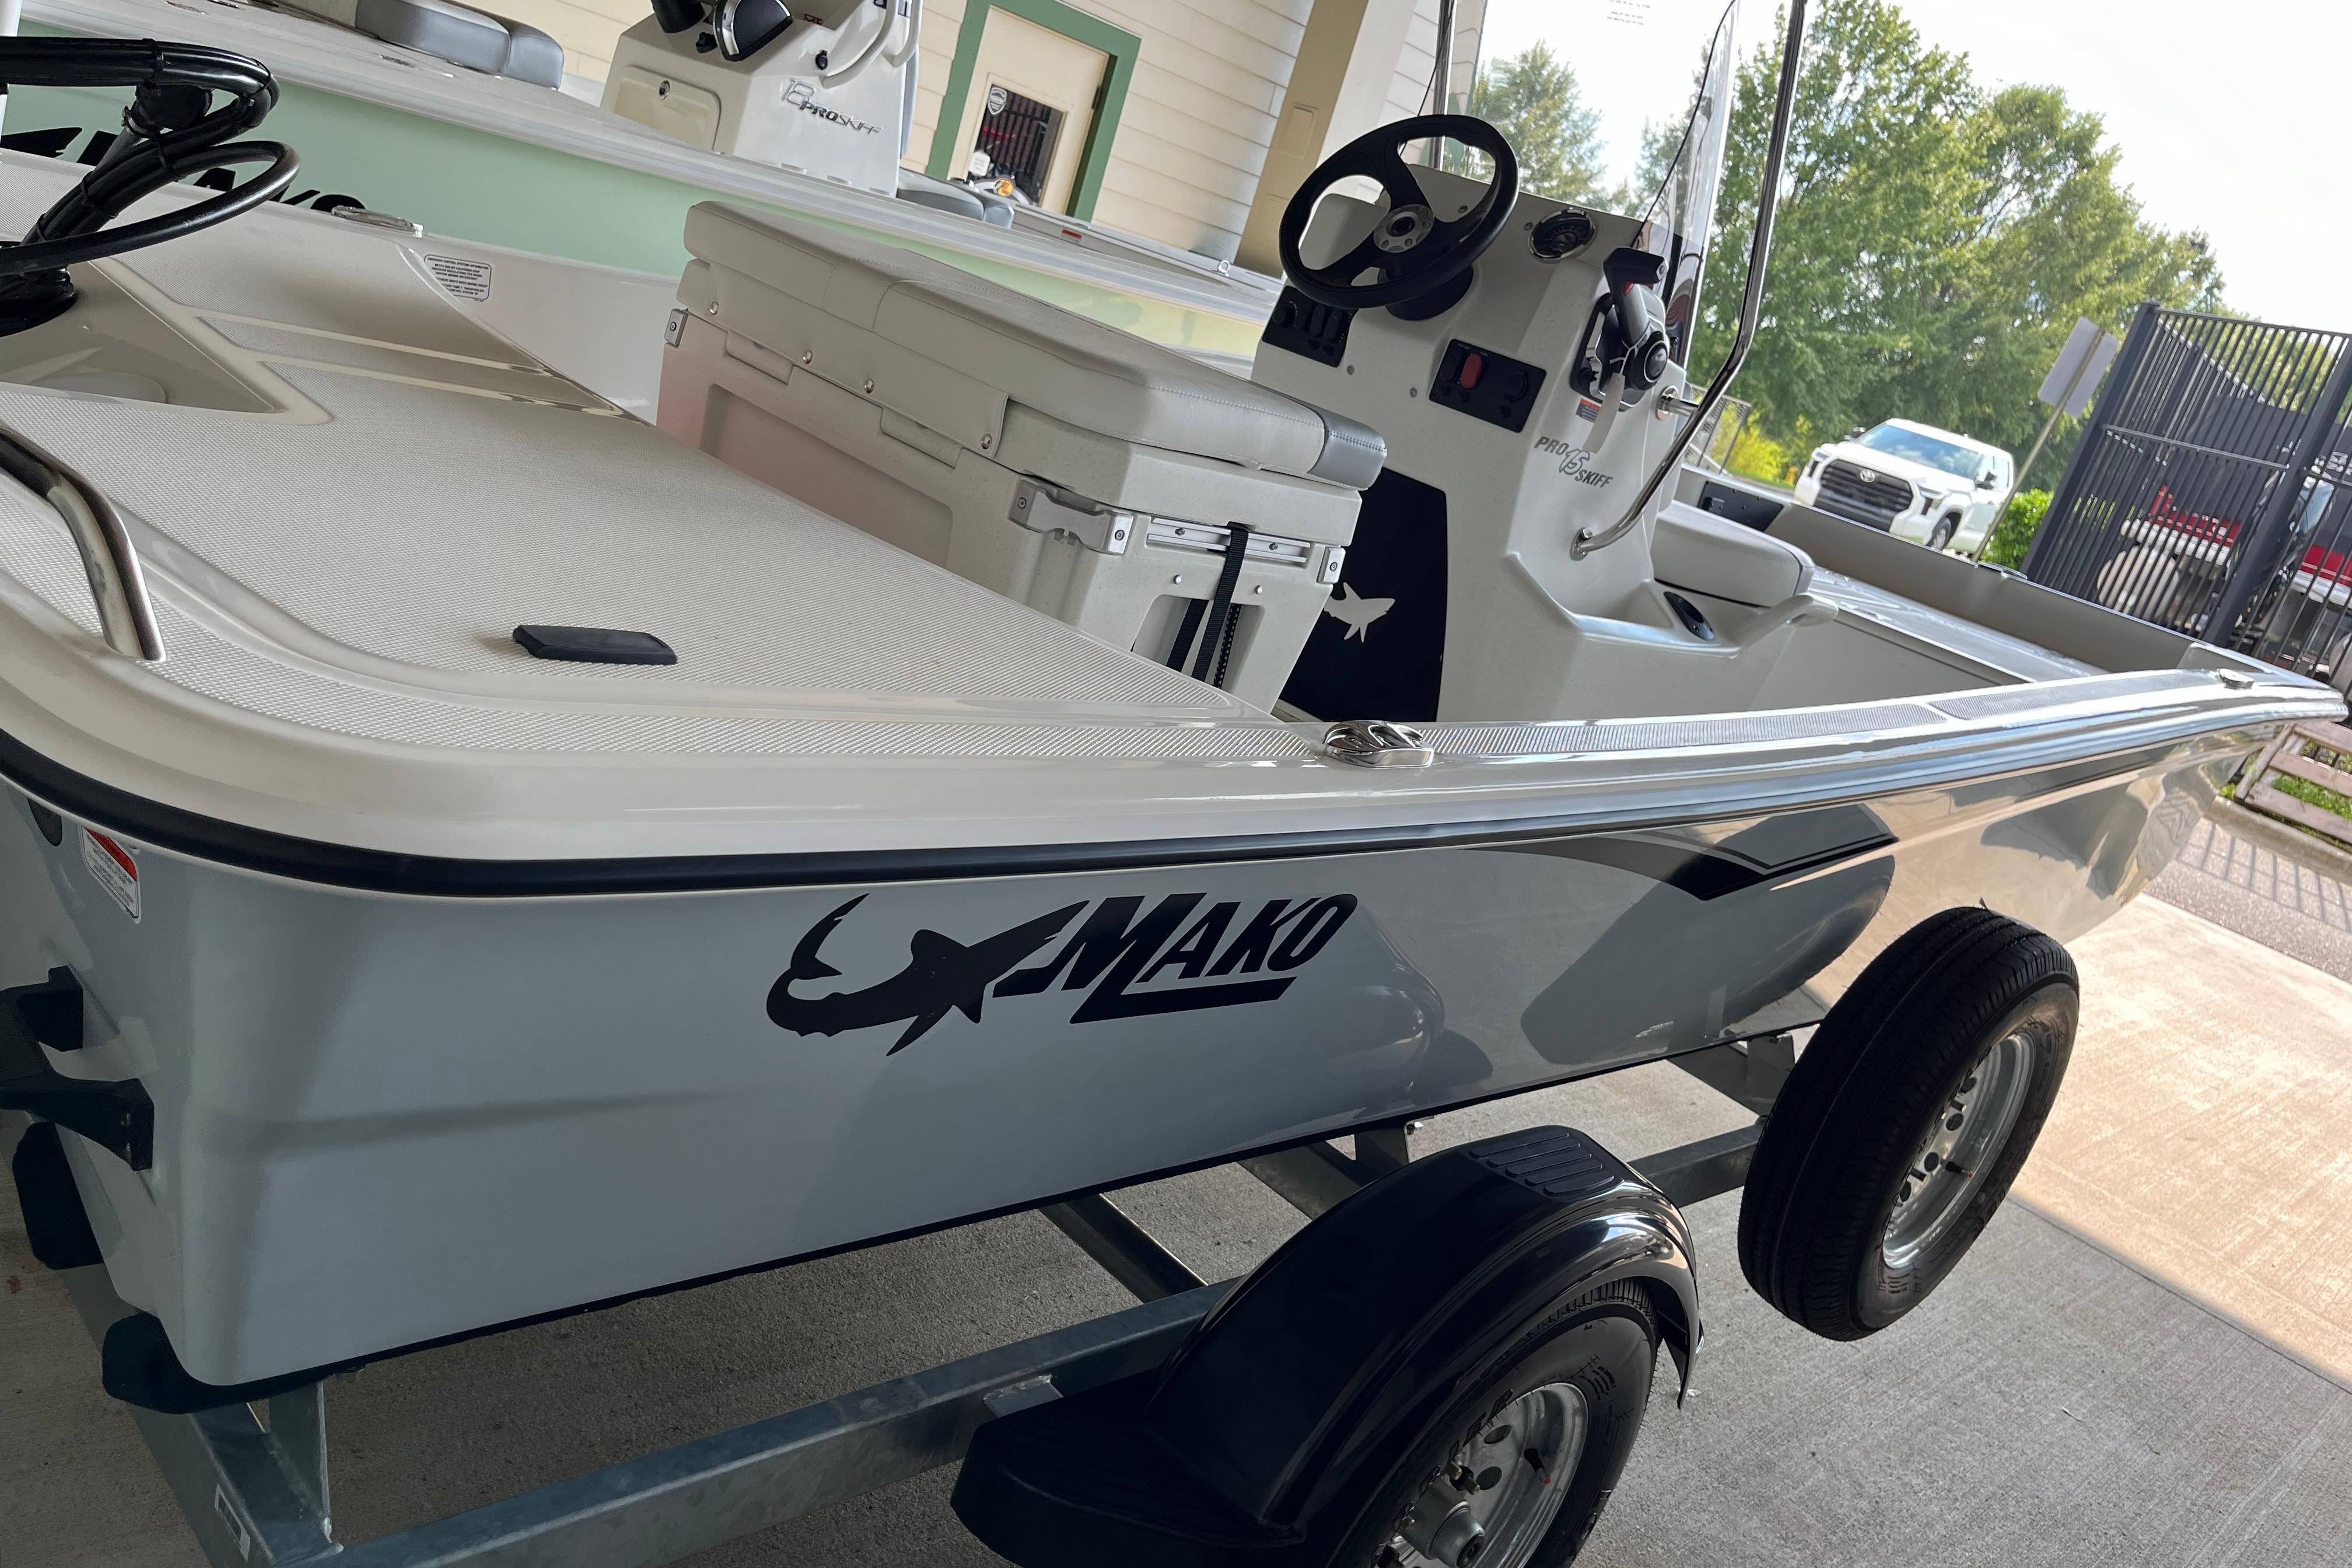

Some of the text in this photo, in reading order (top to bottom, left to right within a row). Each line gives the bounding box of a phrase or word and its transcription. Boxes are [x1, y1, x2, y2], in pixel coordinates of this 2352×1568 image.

[1533, 436, 1614, 488] PRO 15 SKIFF
[993, 892, 1358, 1024] MAKO
